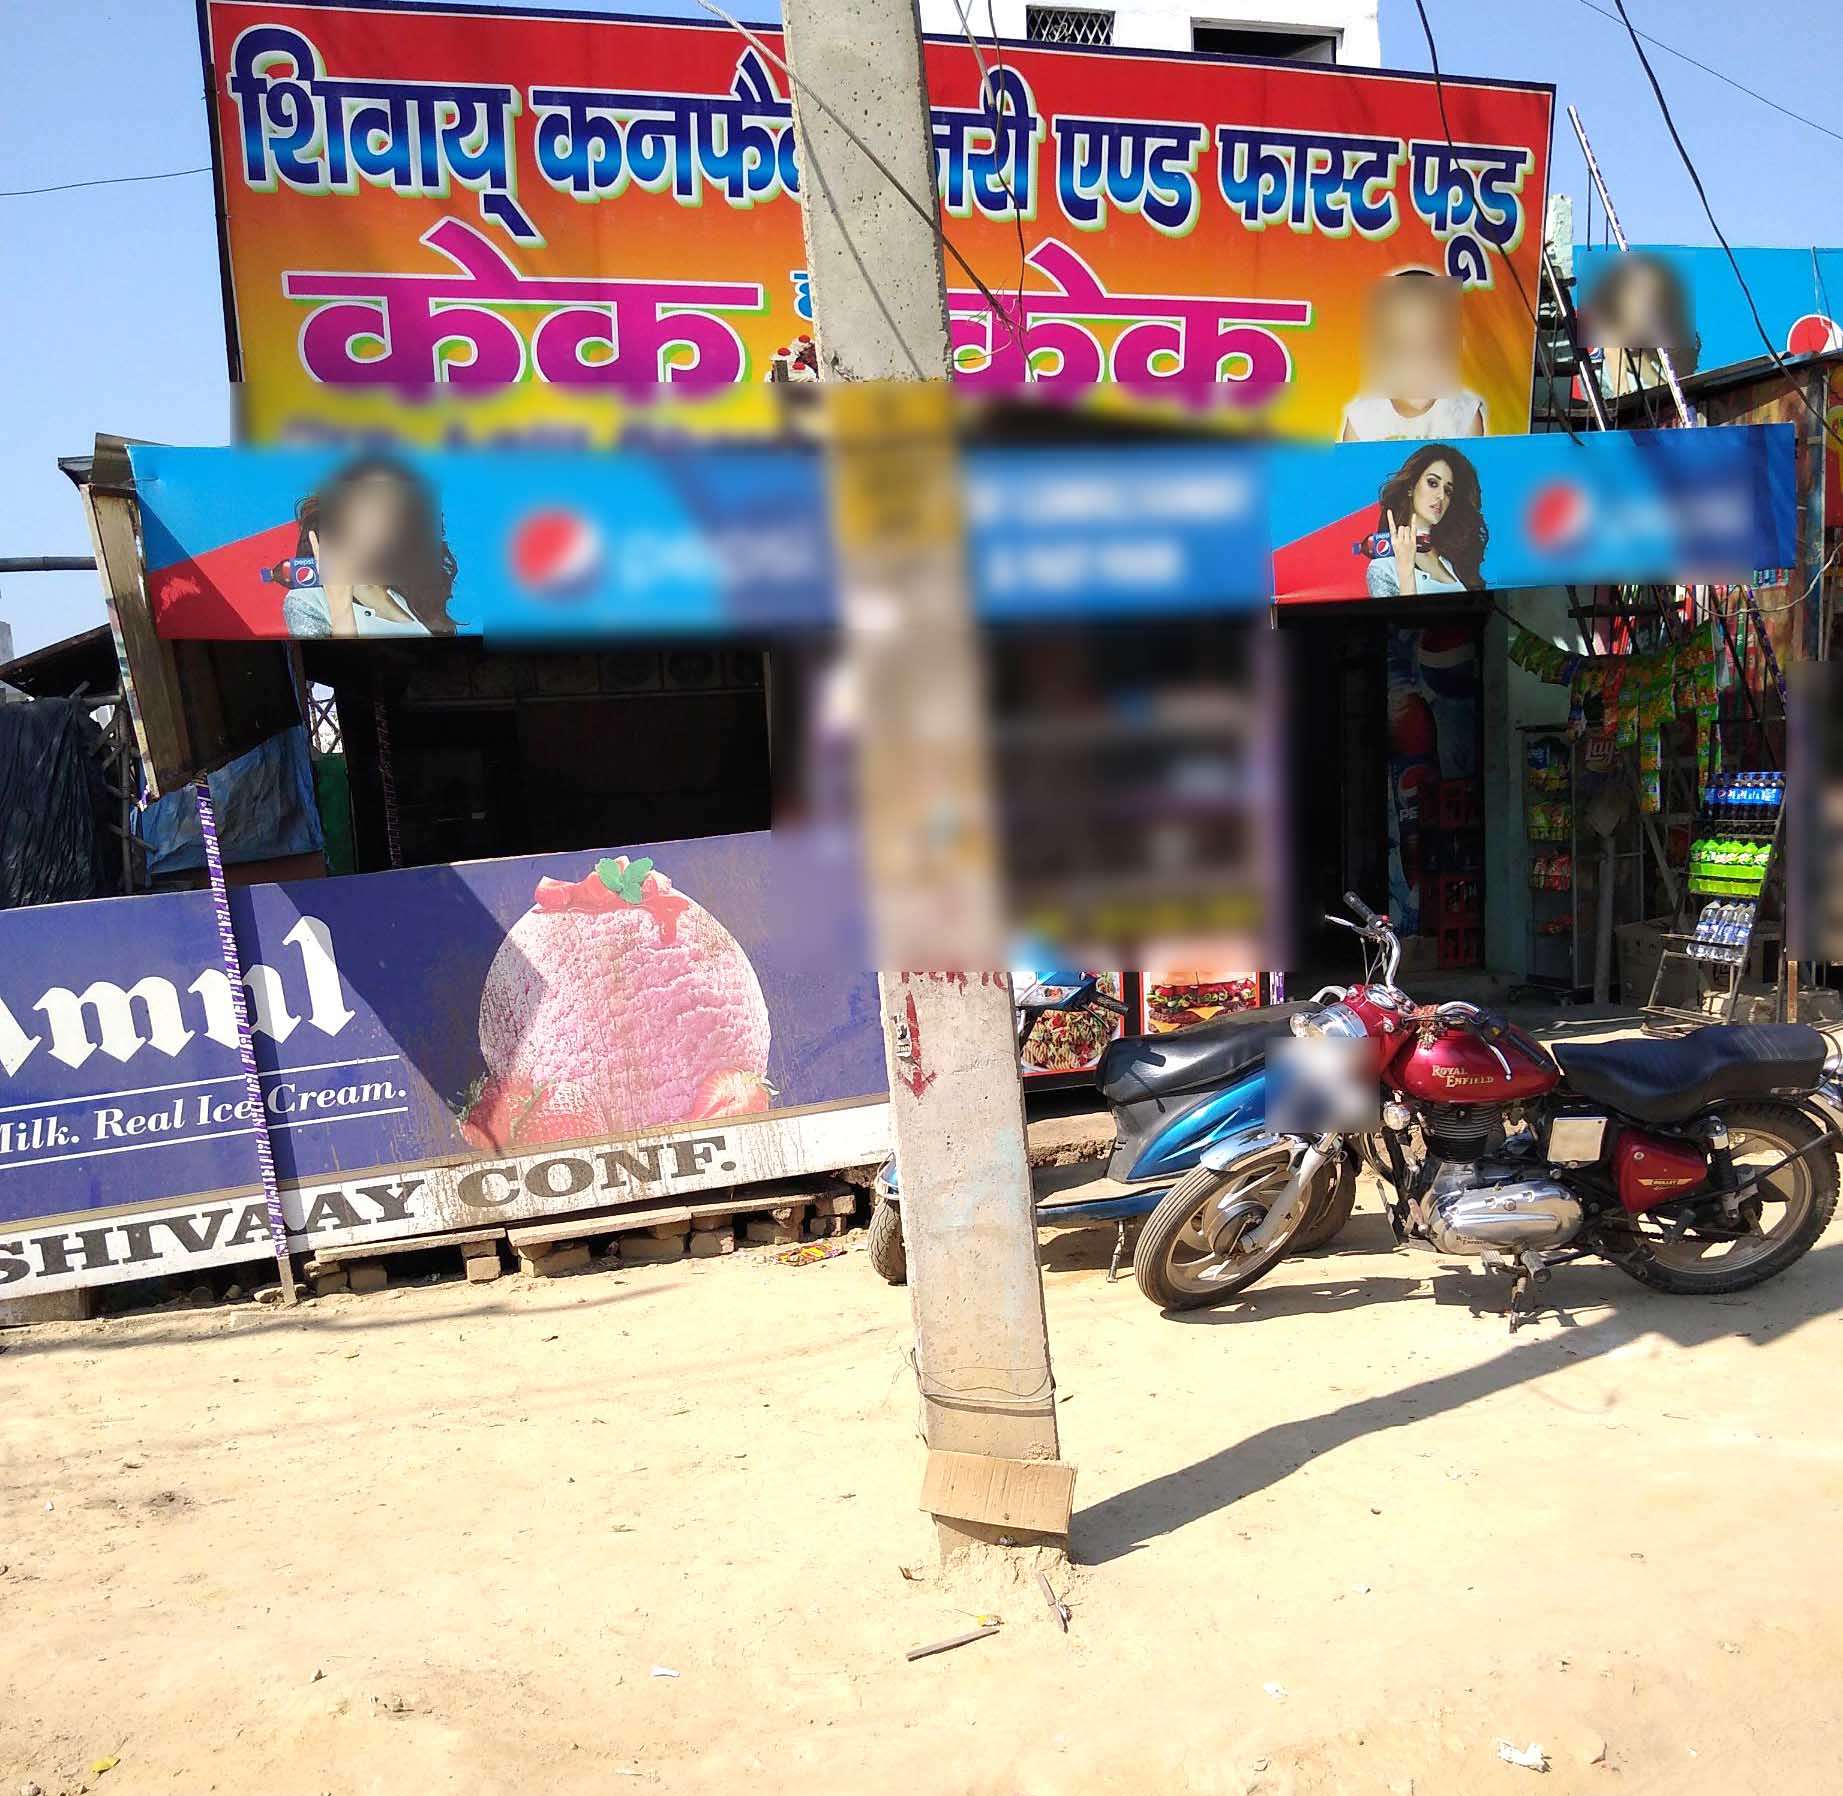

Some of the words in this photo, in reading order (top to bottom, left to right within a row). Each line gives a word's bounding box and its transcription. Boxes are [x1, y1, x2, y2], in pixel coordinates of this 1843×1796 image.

[1055, 115, 1208, 237] एण्ड
[1216, 125, 1406, 239] फास्ट
[1408, 139, 1532, 290] फूड
[283, 216, 771, 403] केक
[93, 1099, 185, 1141] Real
[197, 1095, 255, 1126] Ice
[267, 1081, 408, 1115] Cream.
[457, 1135, 737, 1208] CONF.
